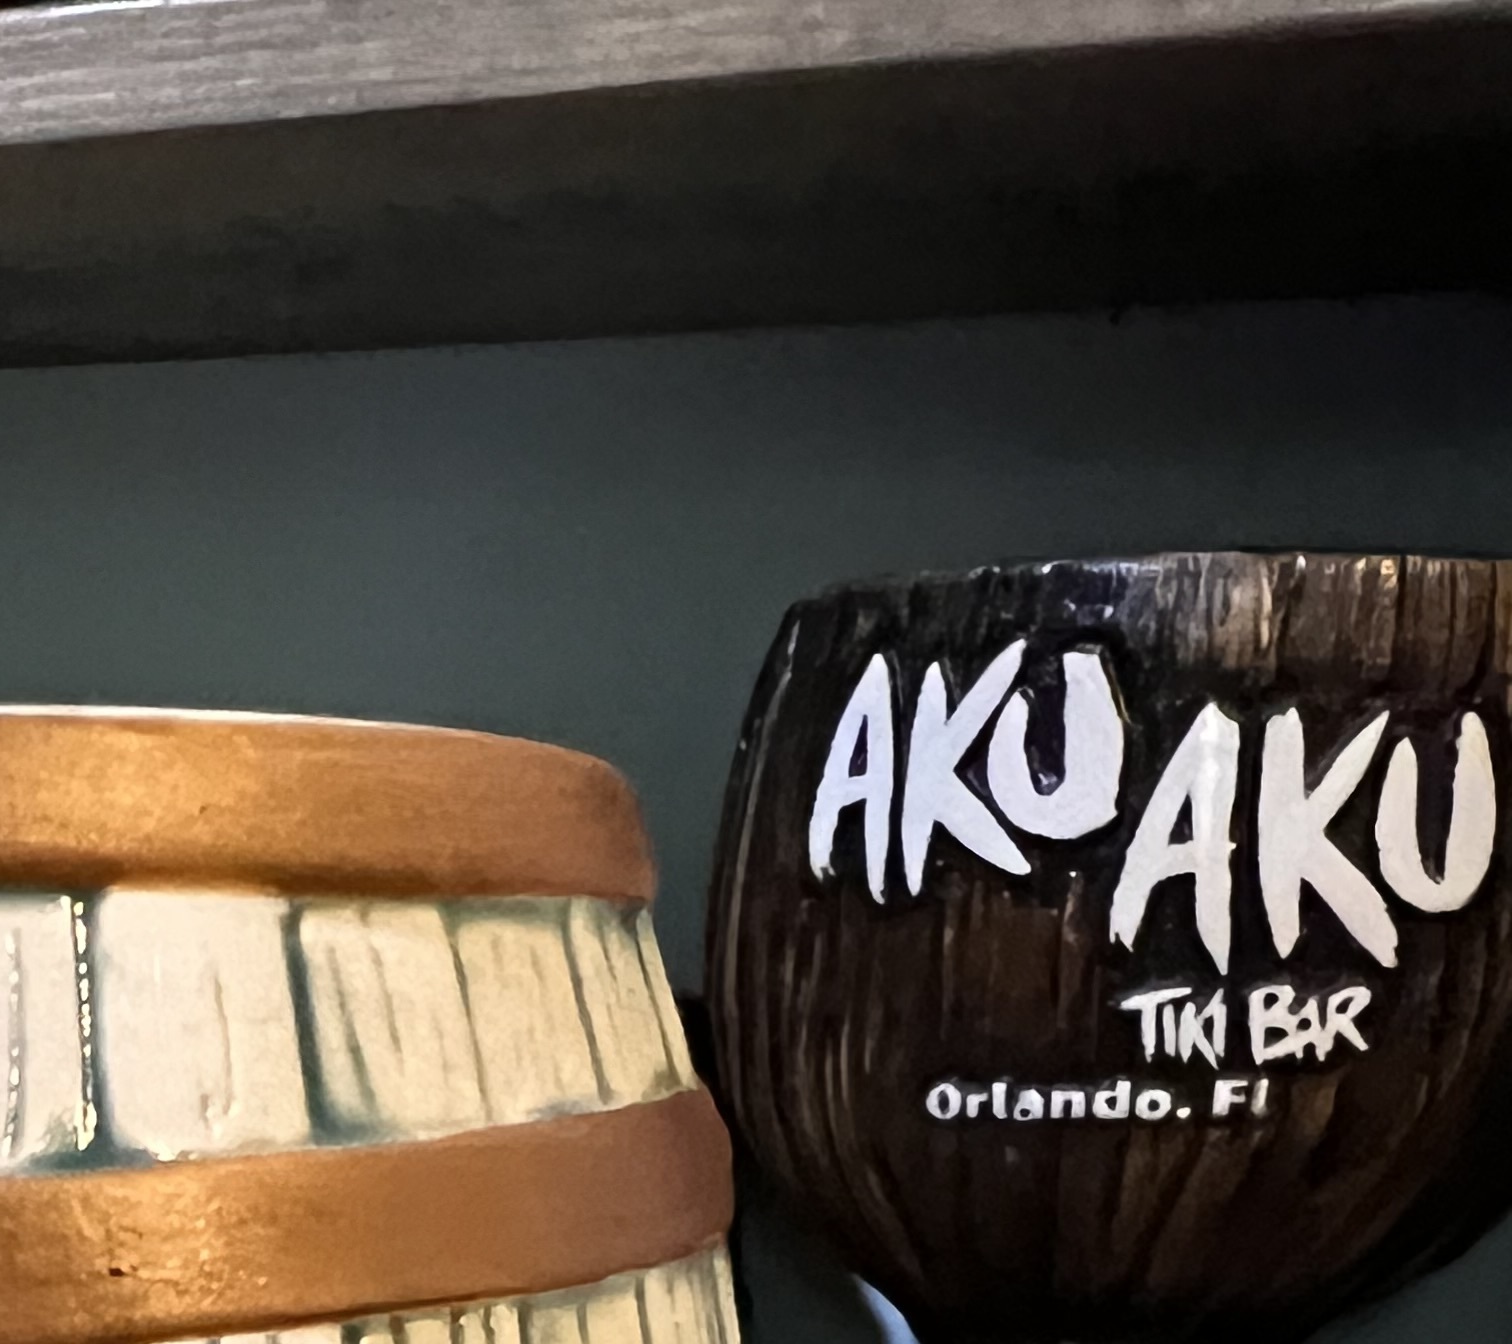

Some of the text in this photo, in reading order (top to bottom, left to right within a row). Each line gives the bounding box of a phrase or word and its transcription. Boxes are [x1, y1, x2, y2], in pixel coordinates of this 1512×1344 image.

[809, 638, 1125, 904] AKU
[1110, 703, 1496, 975] AKU
[1119, 985, 1372, 1070] TIKI BAR
